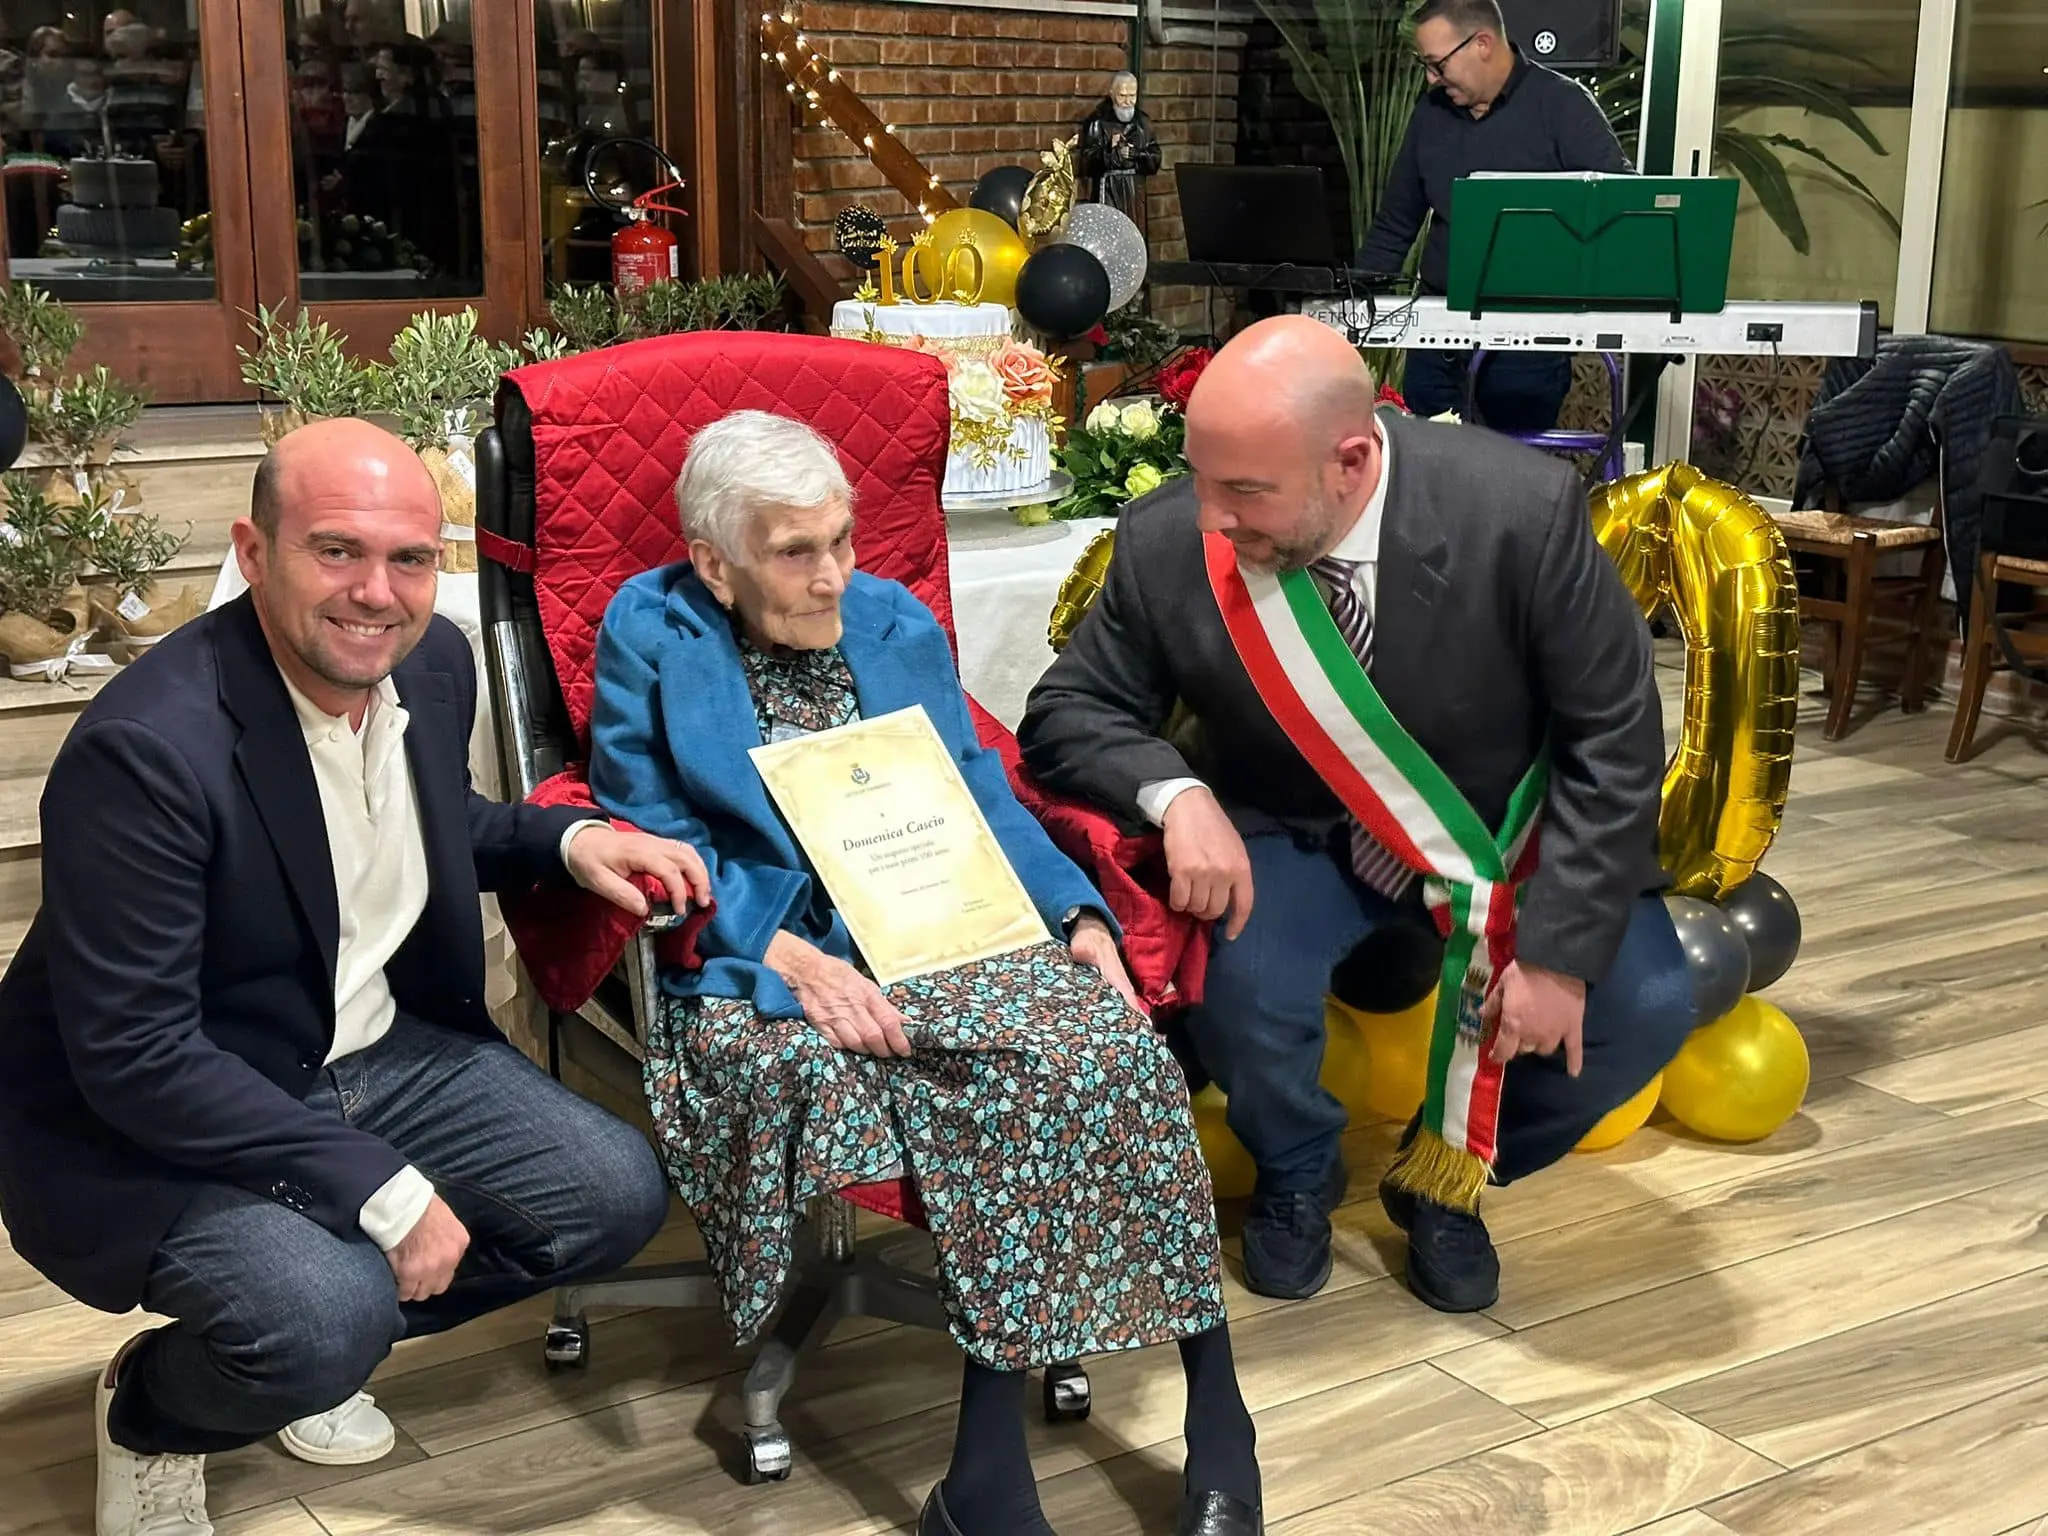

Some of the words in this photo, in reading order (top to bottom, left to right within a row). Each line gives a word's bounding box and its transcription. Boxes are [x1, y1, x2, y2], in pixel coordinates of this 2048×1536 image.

[871, 243, 984, 307] 100
[842, 828, 903, 851] Domenica
[906, 815, 945, 834] Cascio
